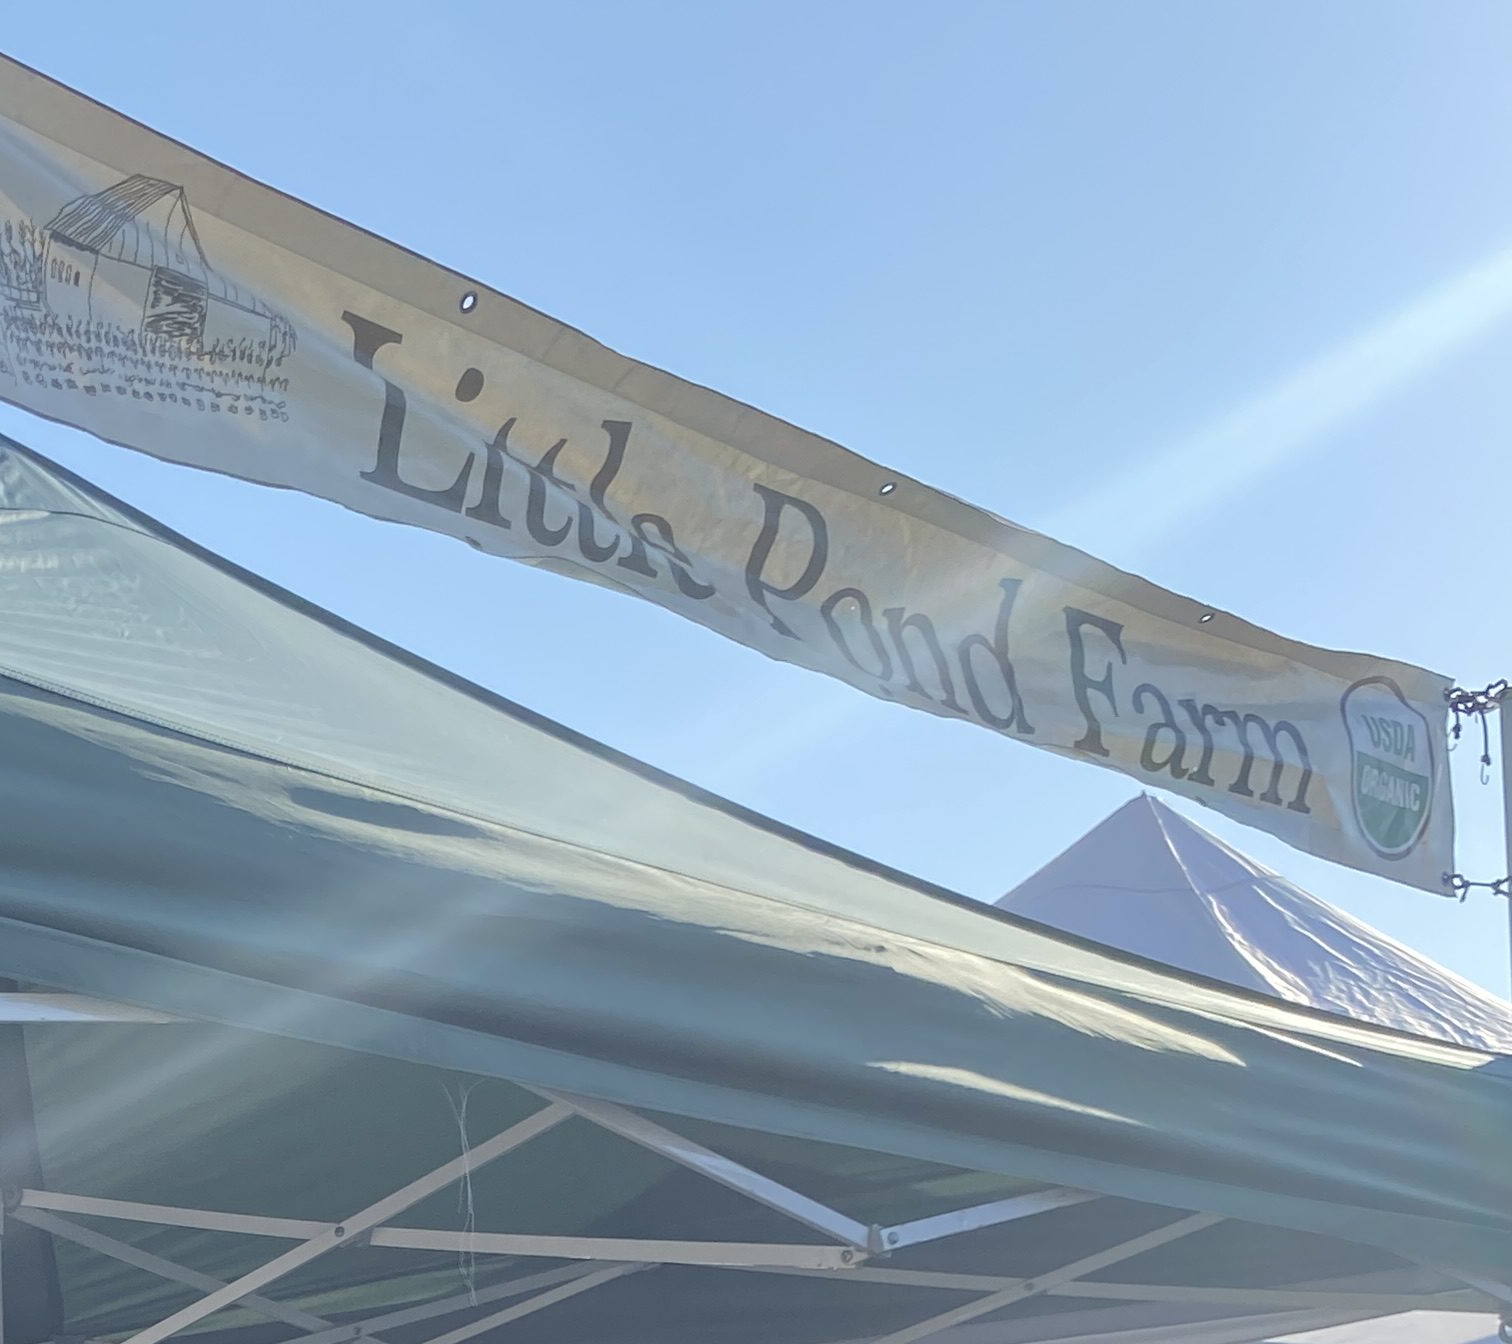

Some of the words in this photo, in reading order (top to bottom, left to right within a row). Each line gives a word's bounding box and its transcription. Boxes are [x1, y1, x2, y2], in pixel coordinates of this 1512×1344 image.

[341, 311, 716, 602] Little
[744, 482, 1035, 736] Pond
[1062, 606, 1313, 815] Farm
[1361, 713, 1417, 763] USDA
[1361, 764, 1422, 813] ORGANIC
